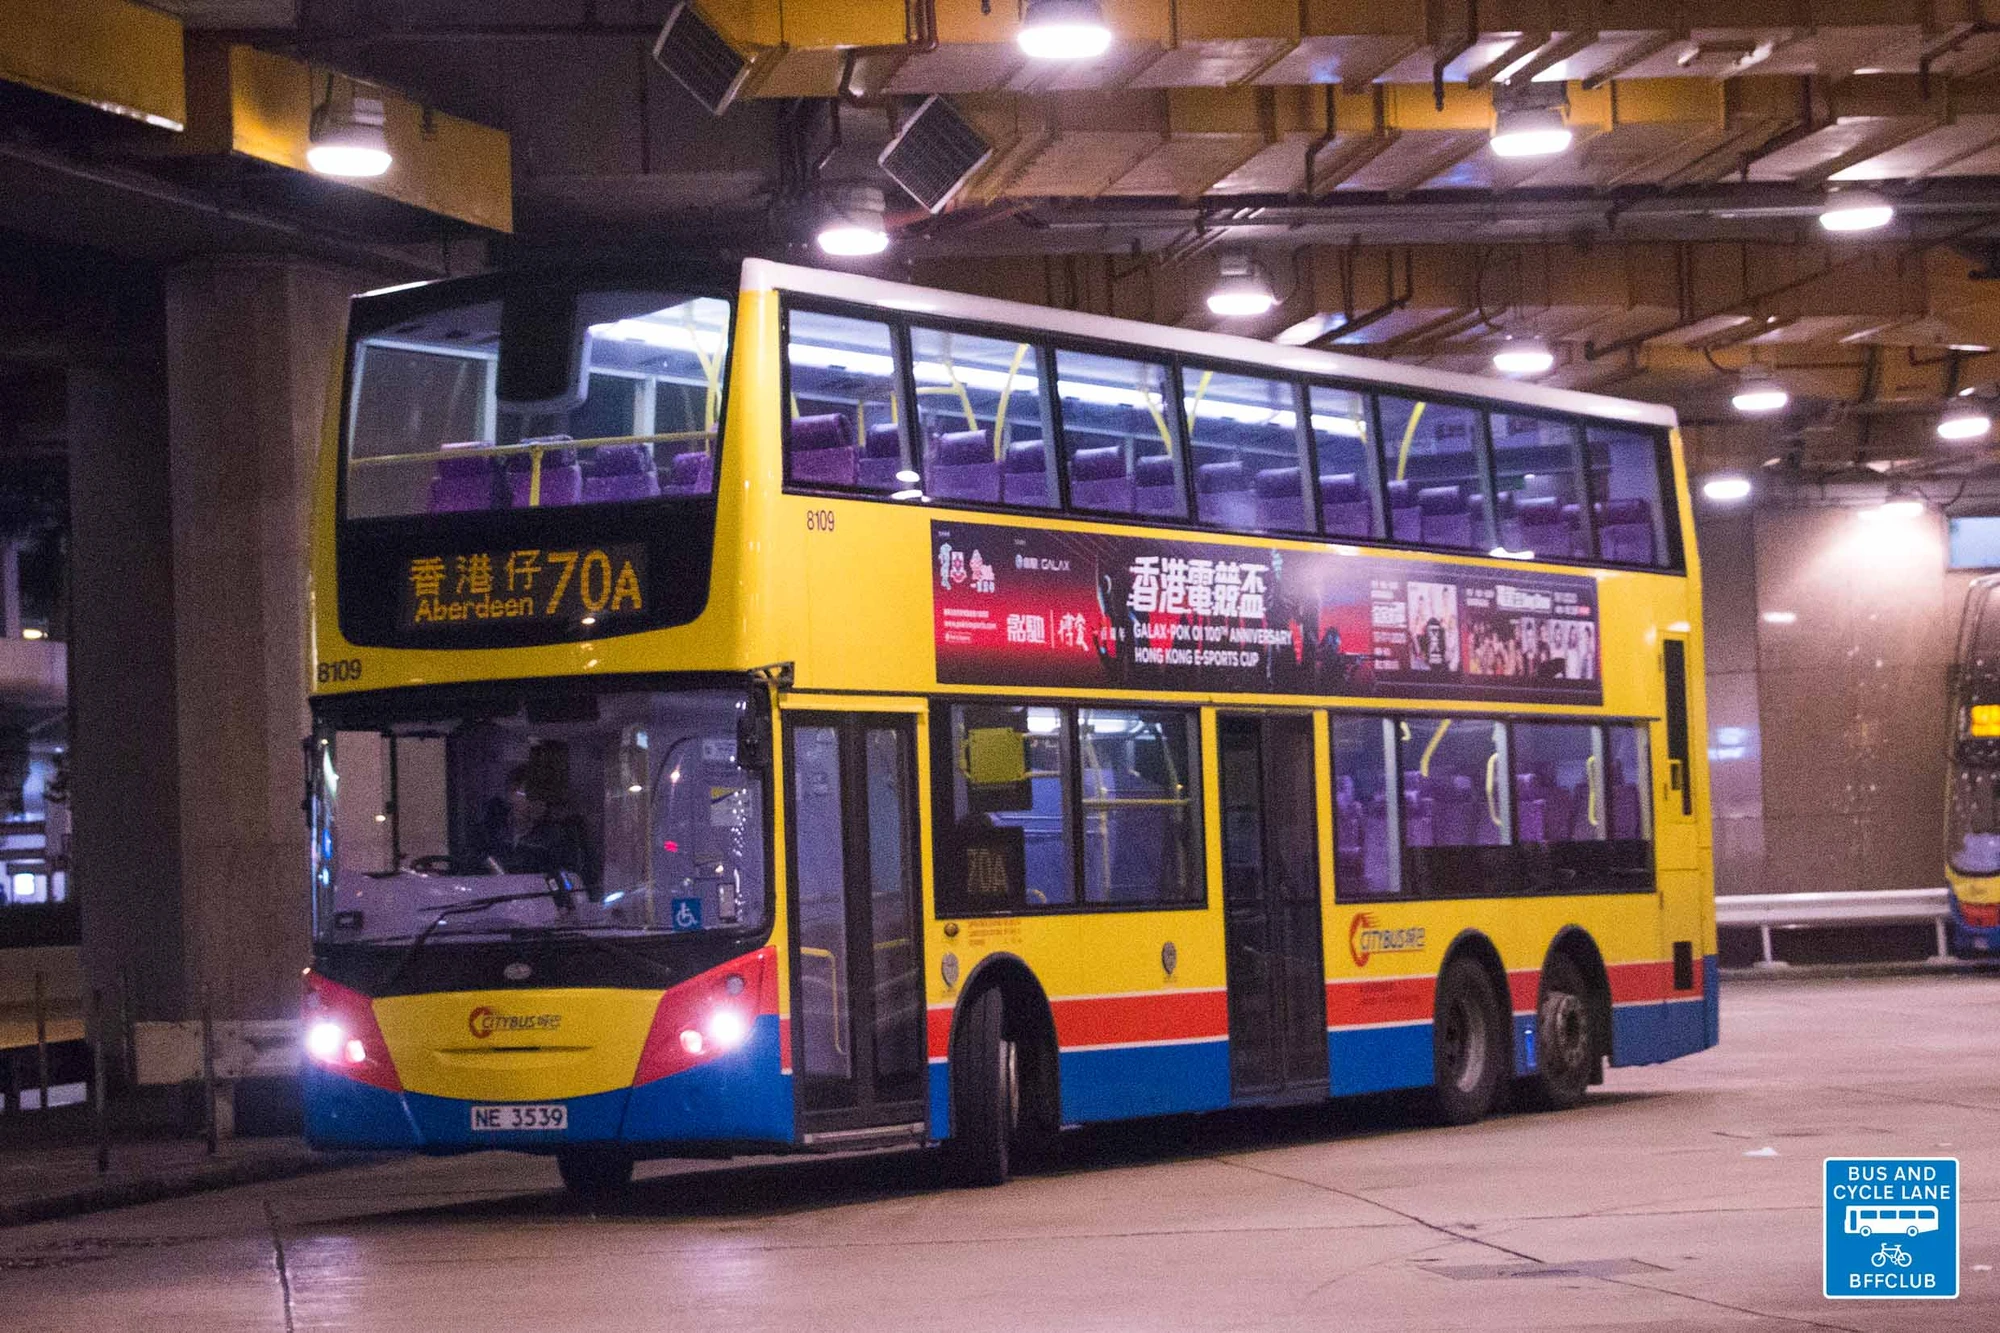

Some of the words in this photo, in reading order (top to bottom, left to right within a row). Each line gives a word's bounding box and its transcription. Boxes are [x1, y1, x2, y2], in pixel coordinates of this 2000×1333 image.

[806, 510, 835, 531] 8109
[409, 548, 542, 598] 香港仔
[1041, 558, 1070, 571] GALAX
[545, 549, 643, 615] 70A
[414, 595, 534, 623] Aberdeen
[1229, 629, 1293, 645] ANNIVERSARY
[1134, 647, 1164, 663] HONG
[1165, 648, 1193, 664] KONG
[1194, 649, 1239, 666] E-SPORTS
[1240, 651, 1259, 667] CUP
[317, 660, 362, 683] 8109
[475, 1108, 501, 1126] NE
[512, 1108, 563, 1126] 3539
